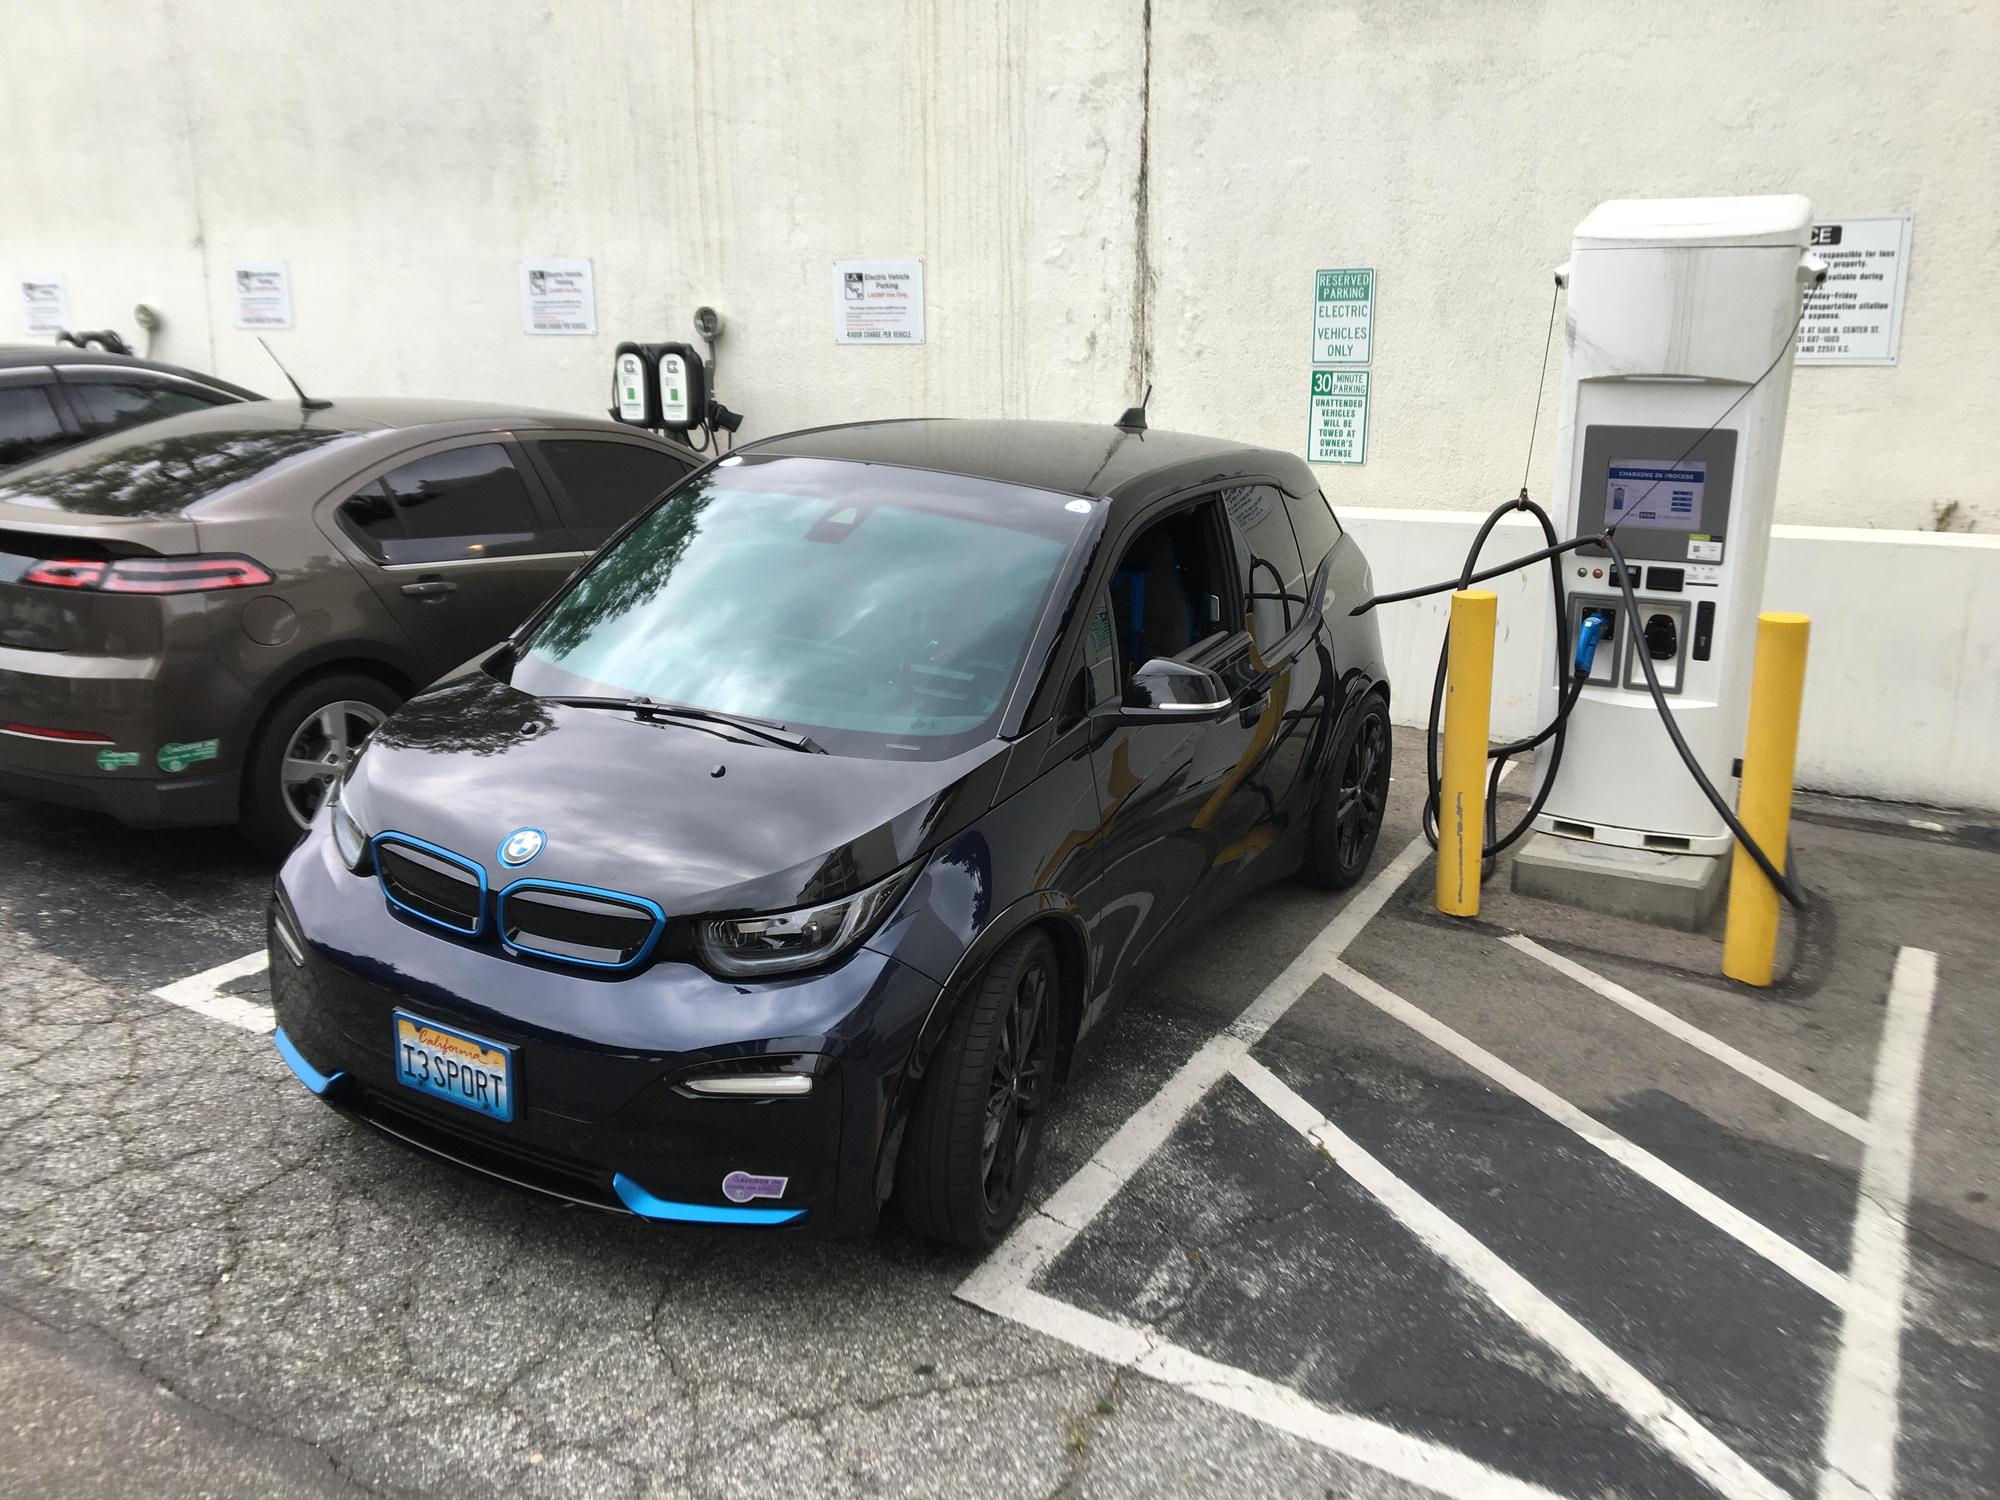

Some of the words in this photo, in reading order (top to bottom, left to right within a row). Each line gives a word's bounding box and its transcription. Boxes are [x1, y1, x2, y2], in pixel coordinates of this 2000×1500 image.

[1865, 250, 1876, 258] for
[1319, 274, 1369, 287] RESERVED
[1828, 272, 1857, 281] vailable
[1323, 287, 1365, 300] PARKING
[1318, 304, 1368, 318] ELECTRIC
[1317, 327, 1367, 340] VEHICLES
[1327, 344, 1354, 357] ONLY
[1314, 373, 1331, 392] 30
[1336, 374, 1364, 384] MINUTE
[1333, 384, 1366, 394] PARKING
[1315, 399, 1363, 408] UNATTENDED
[1321, 408, 1356, 418] VEHICLES
[1323, 419, 1341, 428] WILL
[1343, 419, 1353, 428] BE
[1319, 429, 1345, 438] TOWED
[1346, 429, 1356, 438] AT
[1319, 438, 1353, 448] OWNER'S
[1319, 448, 1352, 458] EXPENSE
[1618, 470, 1654, 478] CHARGING
[418, 1029, 488, 1064] California
